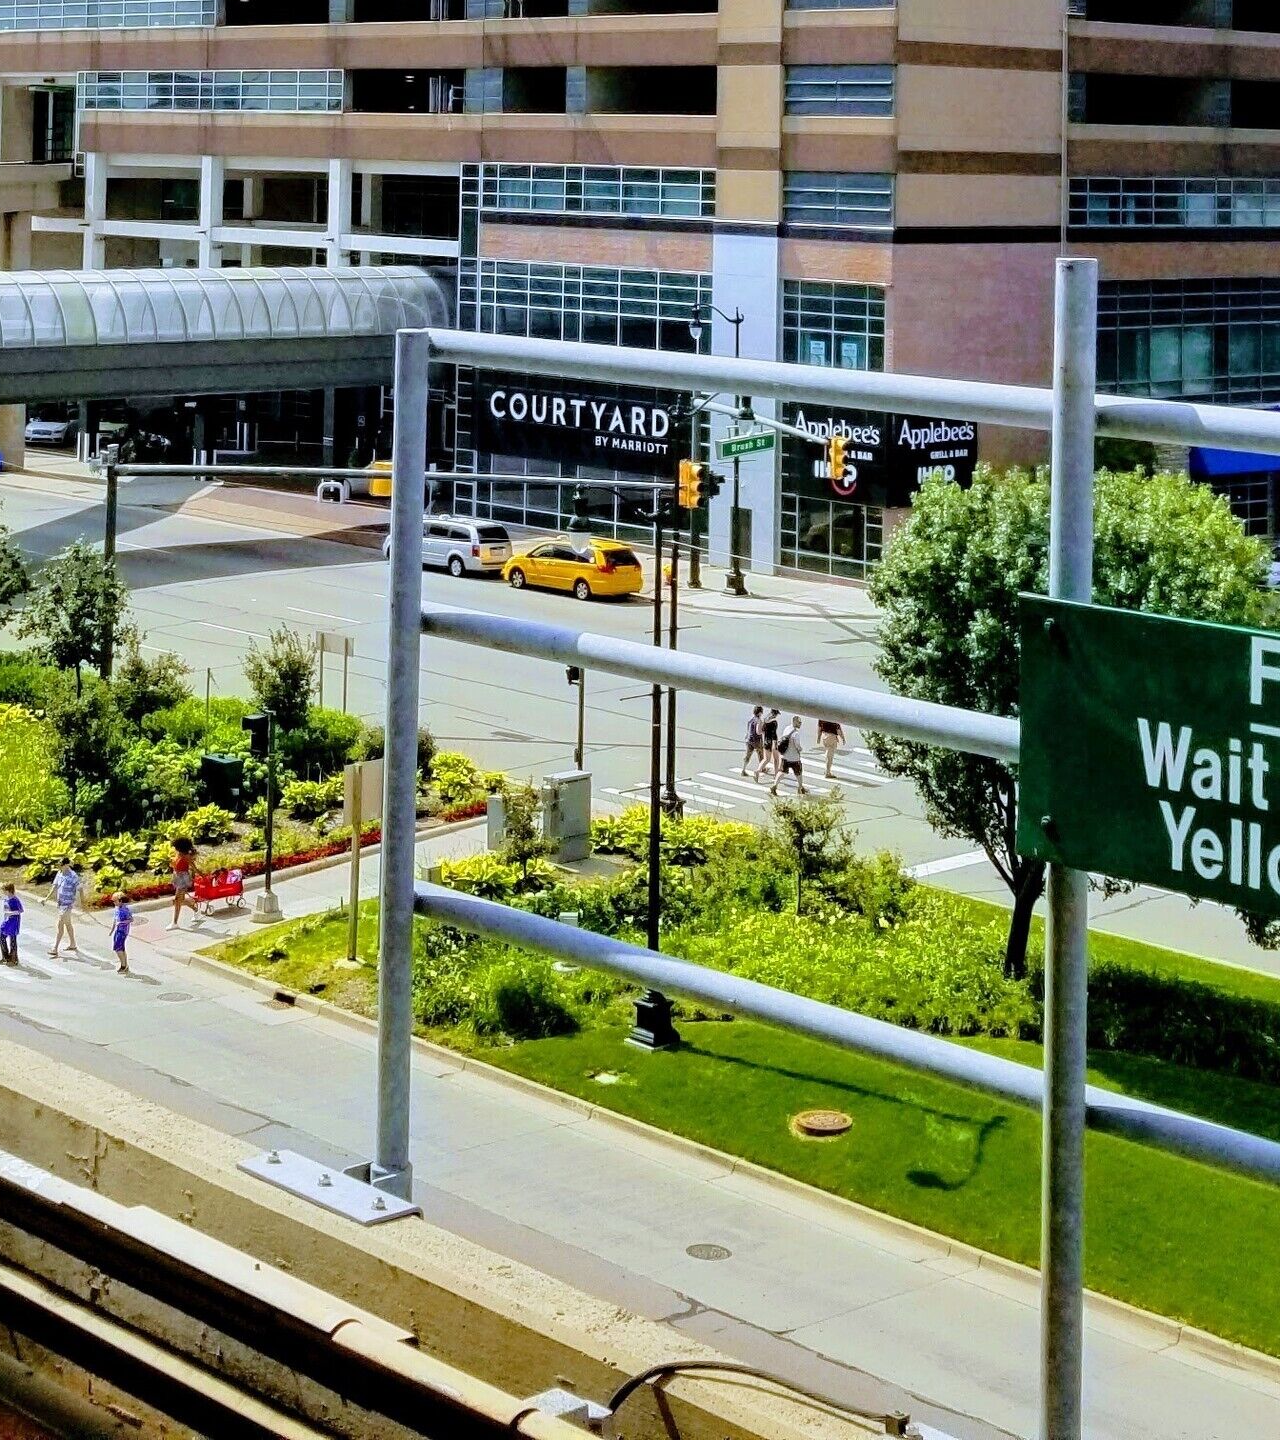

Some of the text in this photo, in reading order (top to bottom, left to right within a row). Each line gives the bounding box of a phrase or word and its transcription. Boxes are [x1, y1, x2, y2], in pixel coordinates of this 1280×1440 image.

[489, 390, 670, 438] COURTYARD
[794, 409, 881, 446] Applebee's
[594, 435, 669, 455] BY MARRIOTT
[731, 438, 766, 452] Brush St
[897, 418, 975, 450] Applebee's
[857, 451, 873, 461] BAR
[929, 450, 949, 460] GRILL
[954, 448, 969, 458] BAR
[814, 459, 857, 488] IHP
[1138, 717, 1269, 811] Wait
